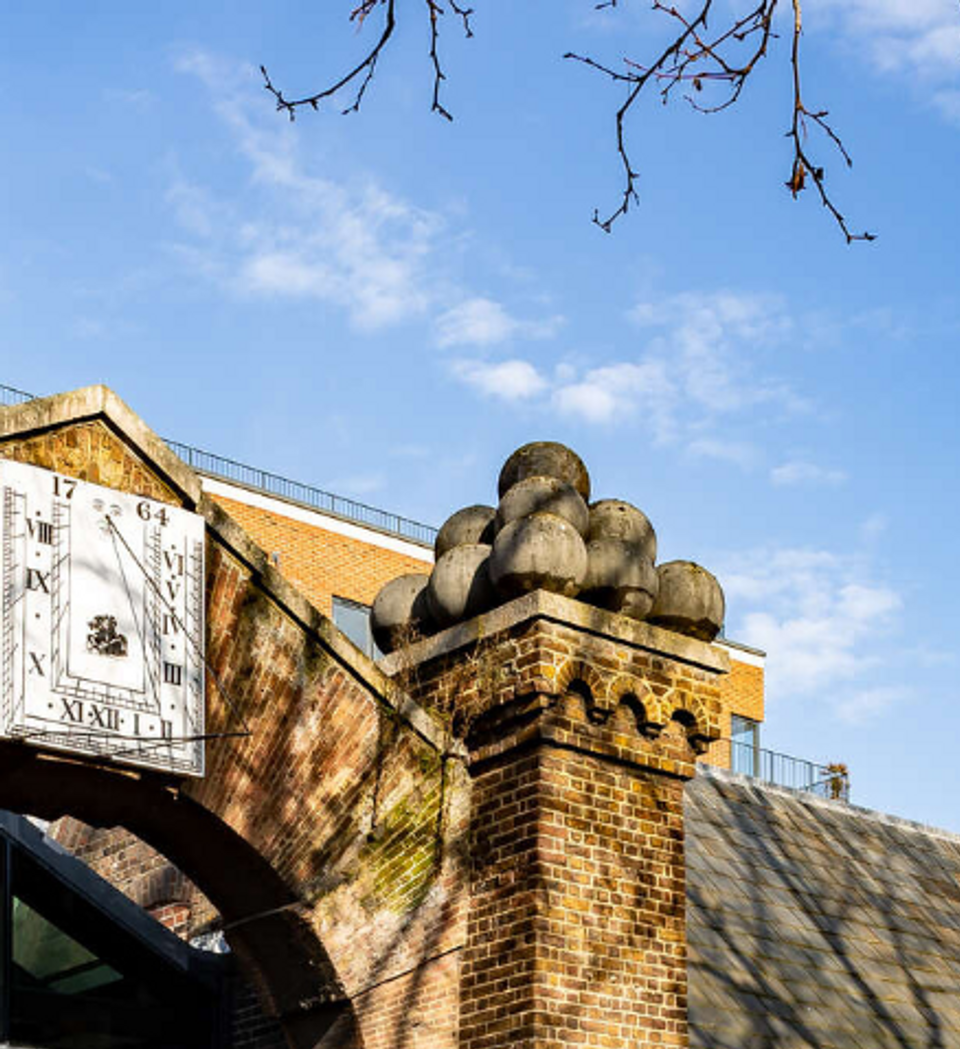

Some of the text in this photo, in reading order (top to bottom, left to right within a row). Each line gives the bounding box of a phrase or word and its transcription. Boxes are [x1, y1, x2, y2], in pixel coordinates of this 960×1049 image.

[53, 476, 170, 526] 17 64
[26, 567, 50, 594] IX
[28, 651, 46, 677] X
